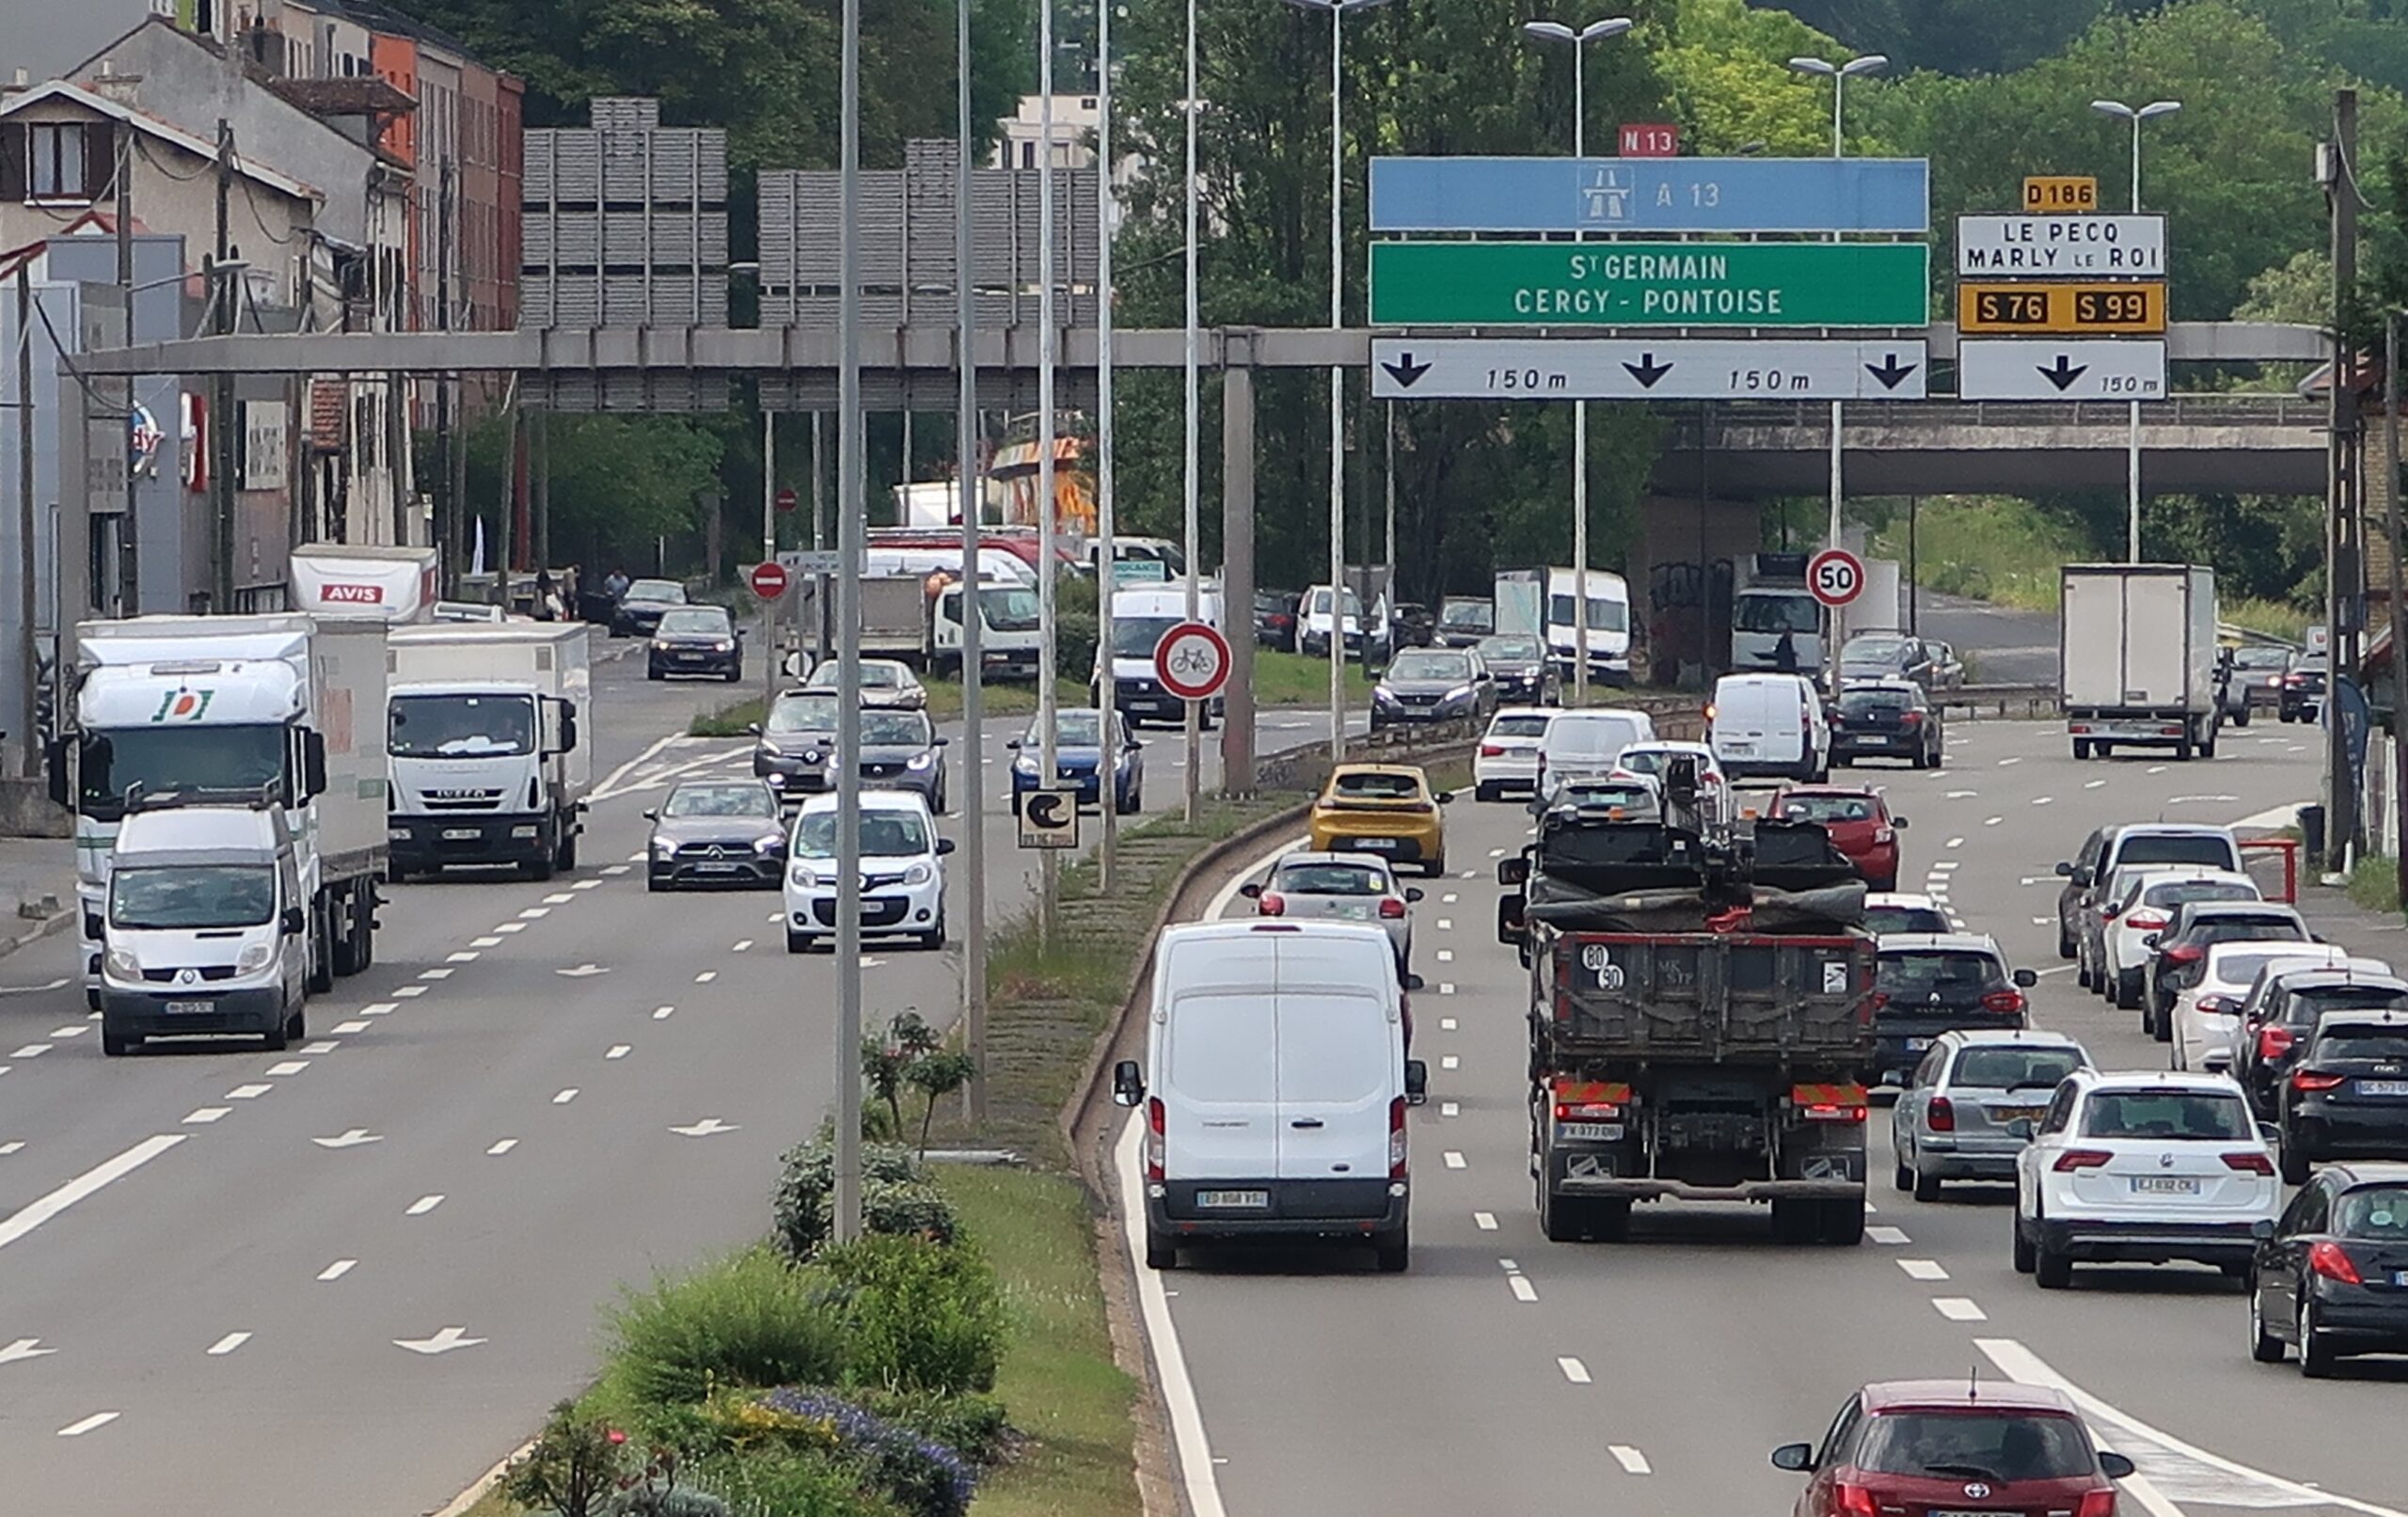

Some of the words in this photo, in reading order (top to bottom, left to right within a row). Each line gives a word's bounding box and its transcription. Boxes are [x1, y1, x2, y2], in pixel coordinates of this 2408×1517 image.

[1625, 132, 1639, 150] N
[1647, 132, 1671, 150] 13
[1656, 183, 1672, 206] A
[1691, 183, 1719, 206] 13
[2028, 185, 2041, 203] D
[2050, 185, 2092, 204] 186
[2004, 224, 2034, 242] LE
[2050, 224, 2118, 242] PECQ
[1605, 255, 1726, 279] GERMAIN
[1968, 248, 2058, 267] MARLY
[2074, 255, 2095, 267] LE
[2110, 248, 2157, 267] ROI
[1514, 290, 1610, 313] CERGY
[1644, 290, 1782, 313] PONTOISE
[1983, 295, 1999, 320] S
[2008, 295, 2043, 320] 76
[2080, 295, 2096, 320] S
[2106, 295, 2143, 320] 99
[1488, 369, 1539, 388] 150
[1548, 374, 1567, 388] m
[1731, 370, 1782, 389] 150
[1791, 375, 1809, 389] m
[2102, 377, 2136, 391] 150
[2143, 379, 2158, 391] m
[1820, 566, 1853, 589] 50
[327, 586, 376, 601] AVIS
[436, 789, 486, 799] IVECO
[1602, 969, 1620, 988] 90
